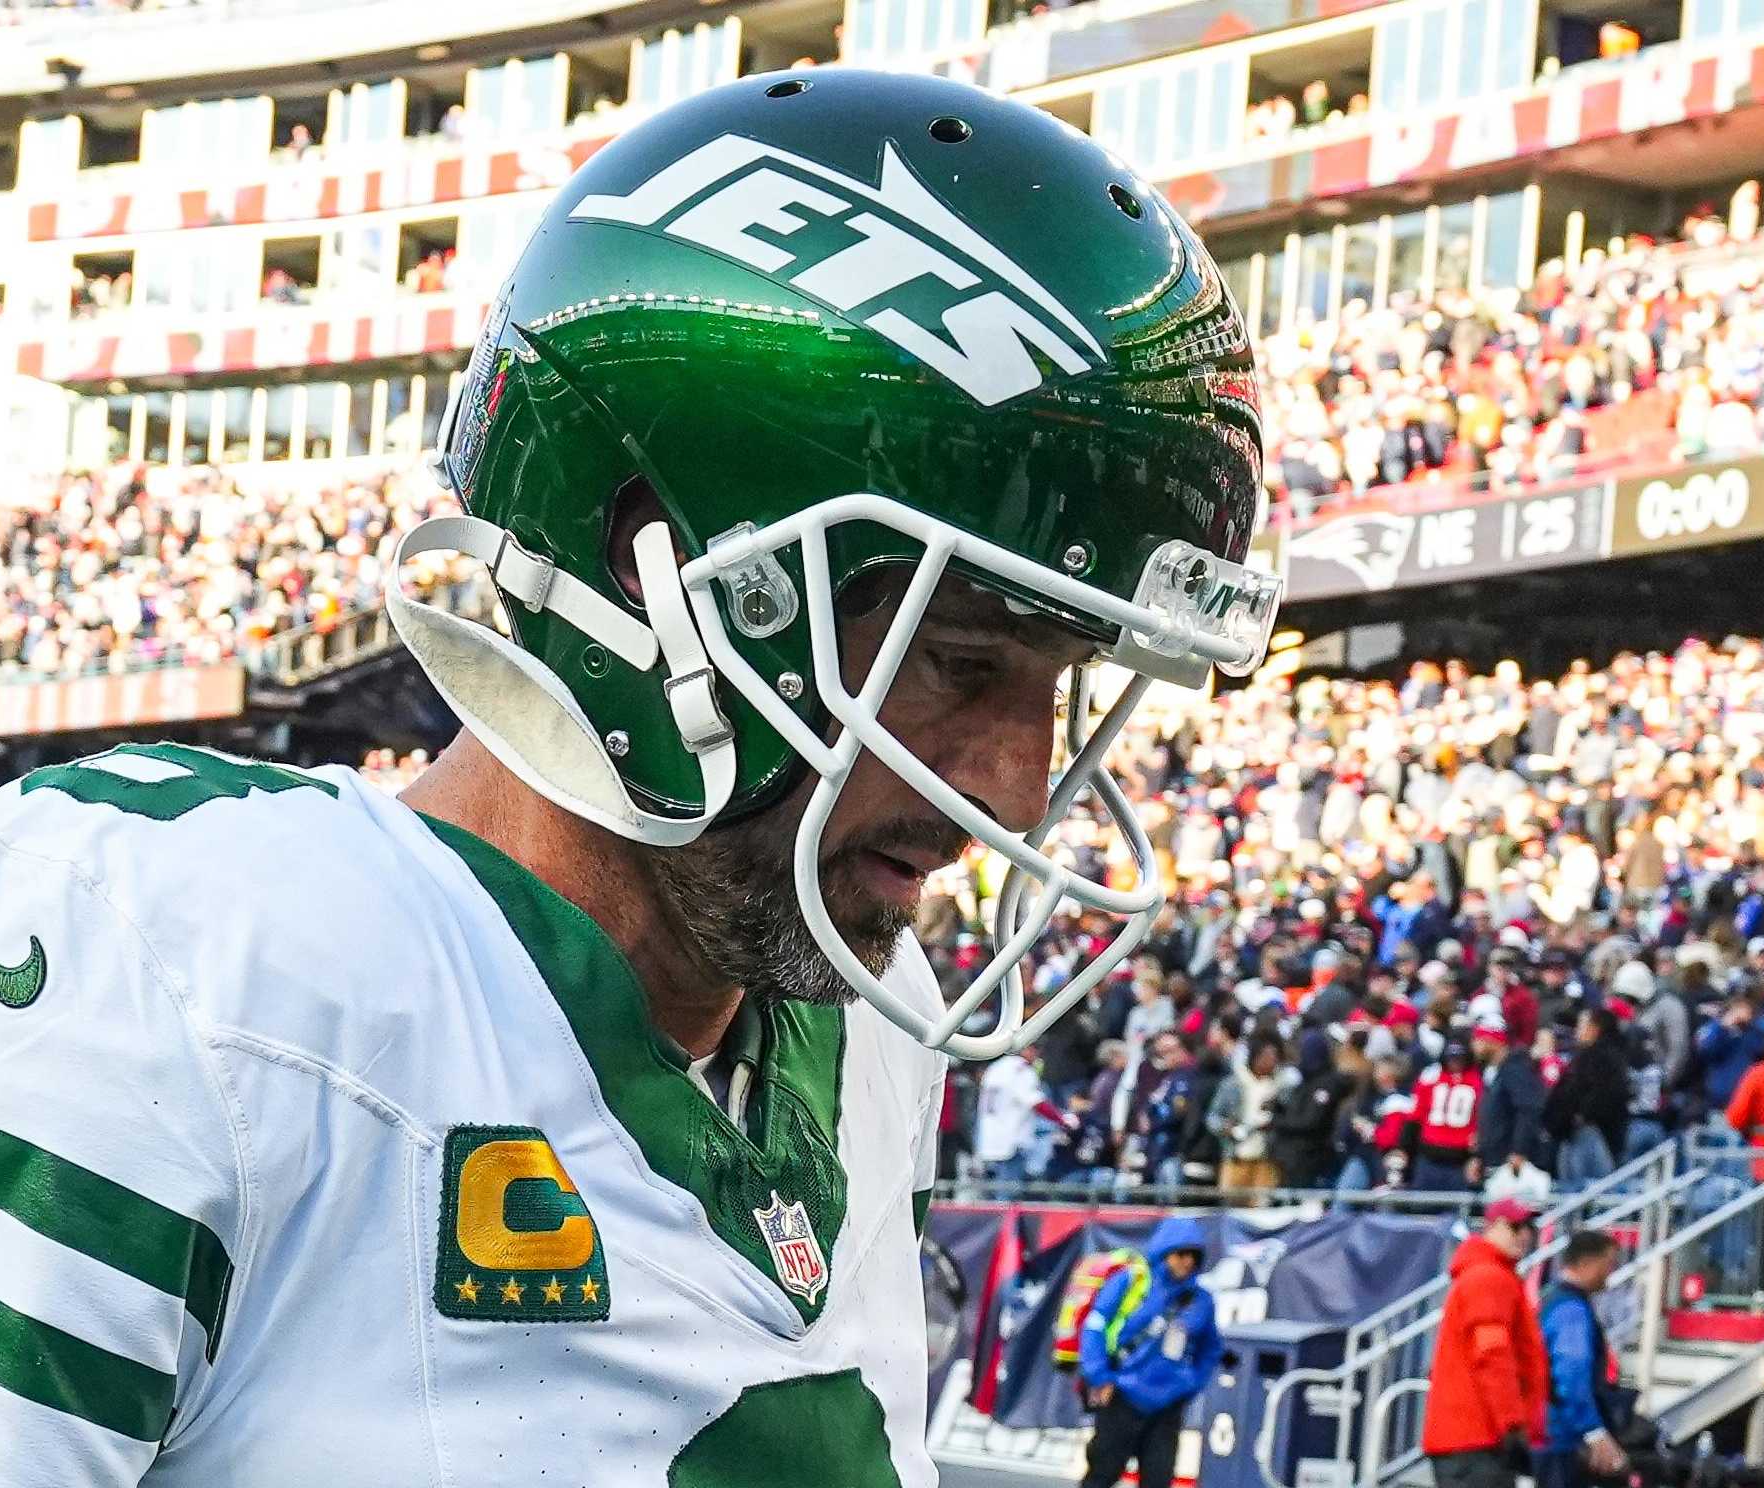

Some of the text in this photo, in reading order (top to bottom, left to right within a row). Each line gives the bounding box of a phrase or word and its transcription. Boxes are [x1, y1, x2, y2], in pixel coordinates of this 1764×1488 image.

[567, 133, 1108, 407] JETS
[1417, 496, 1577, 570] NE 25
[1636, 468, 1750, 541] 0:00
[1428, 1082, 1477, 1129] 10
[456, 1140, 594, 1270] C
[779, 1242, 822, 1284] NFL
